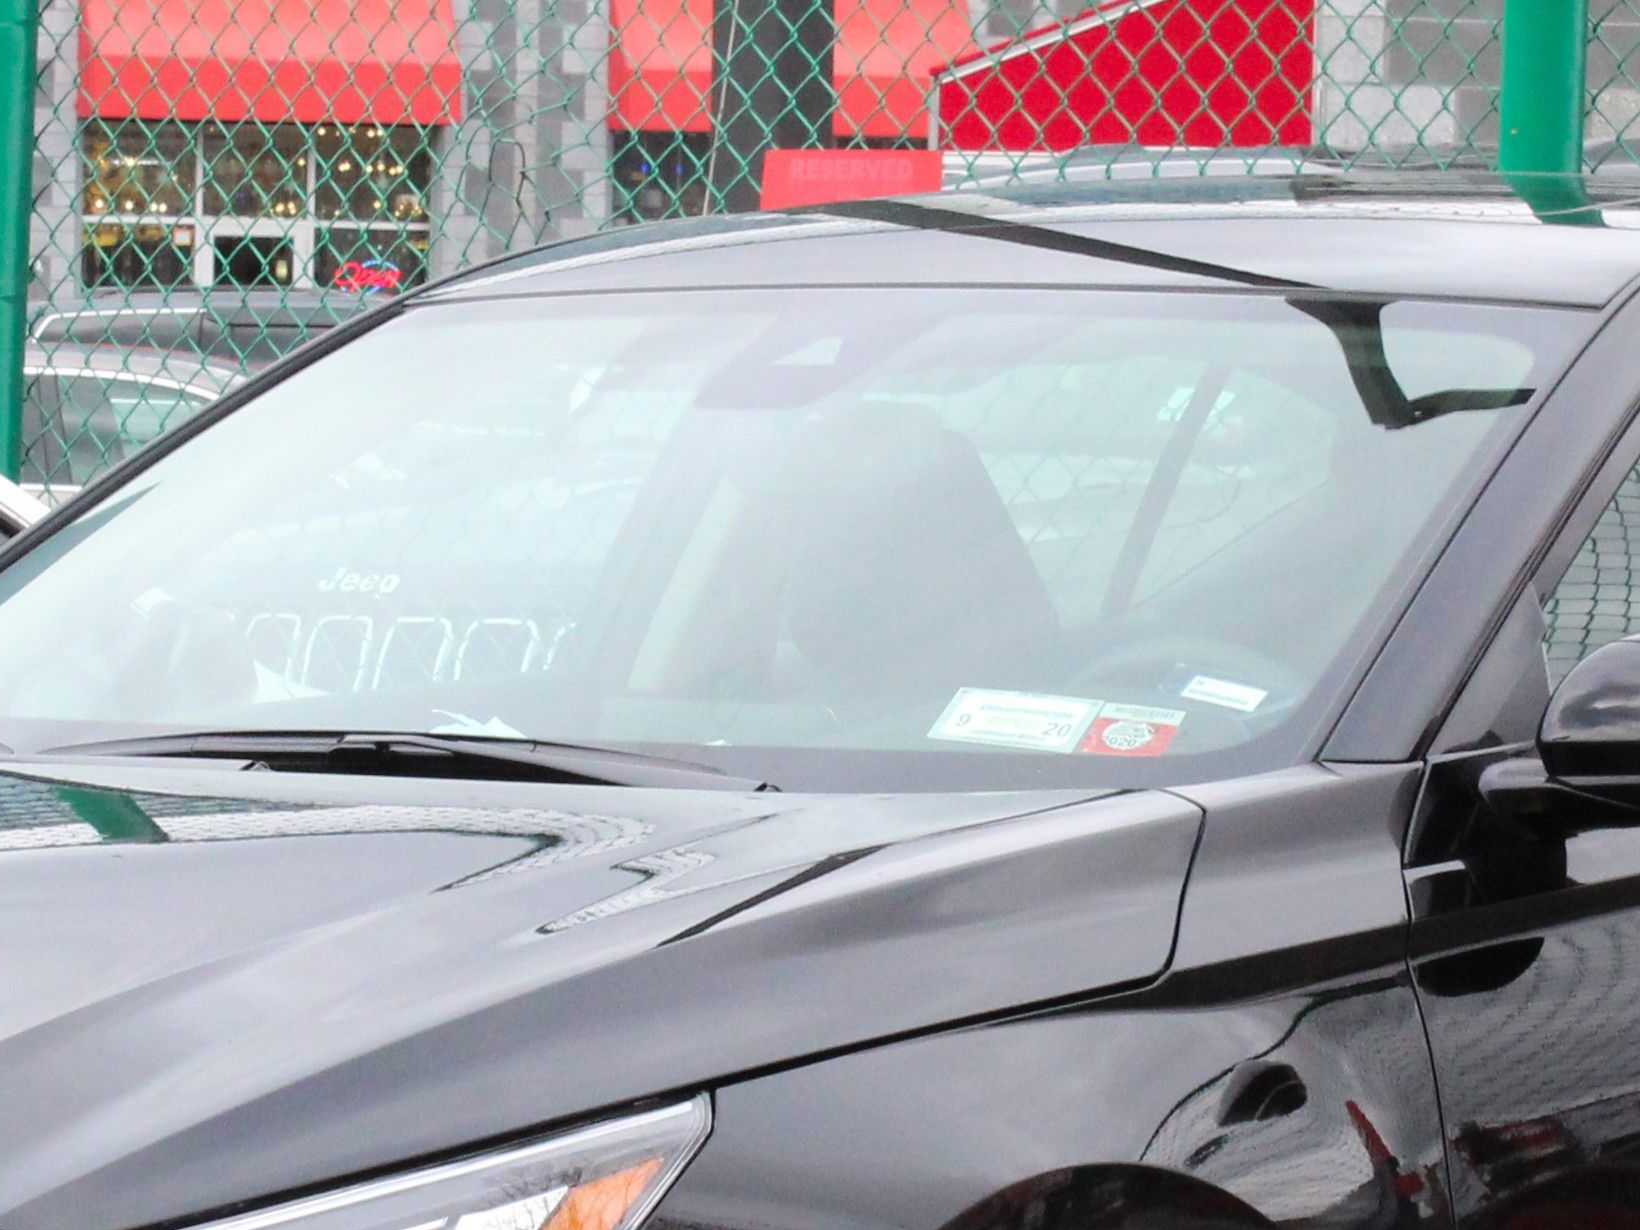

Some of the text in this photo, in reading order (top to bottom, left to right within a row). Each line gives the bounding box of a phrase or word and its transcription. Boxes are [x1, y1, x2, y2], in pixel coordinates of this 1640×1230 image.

[790, 158, 913, 180] RESERVED
[318, 567, 401, 593] Jeep
[1041, 721, 1073, 738] 20
